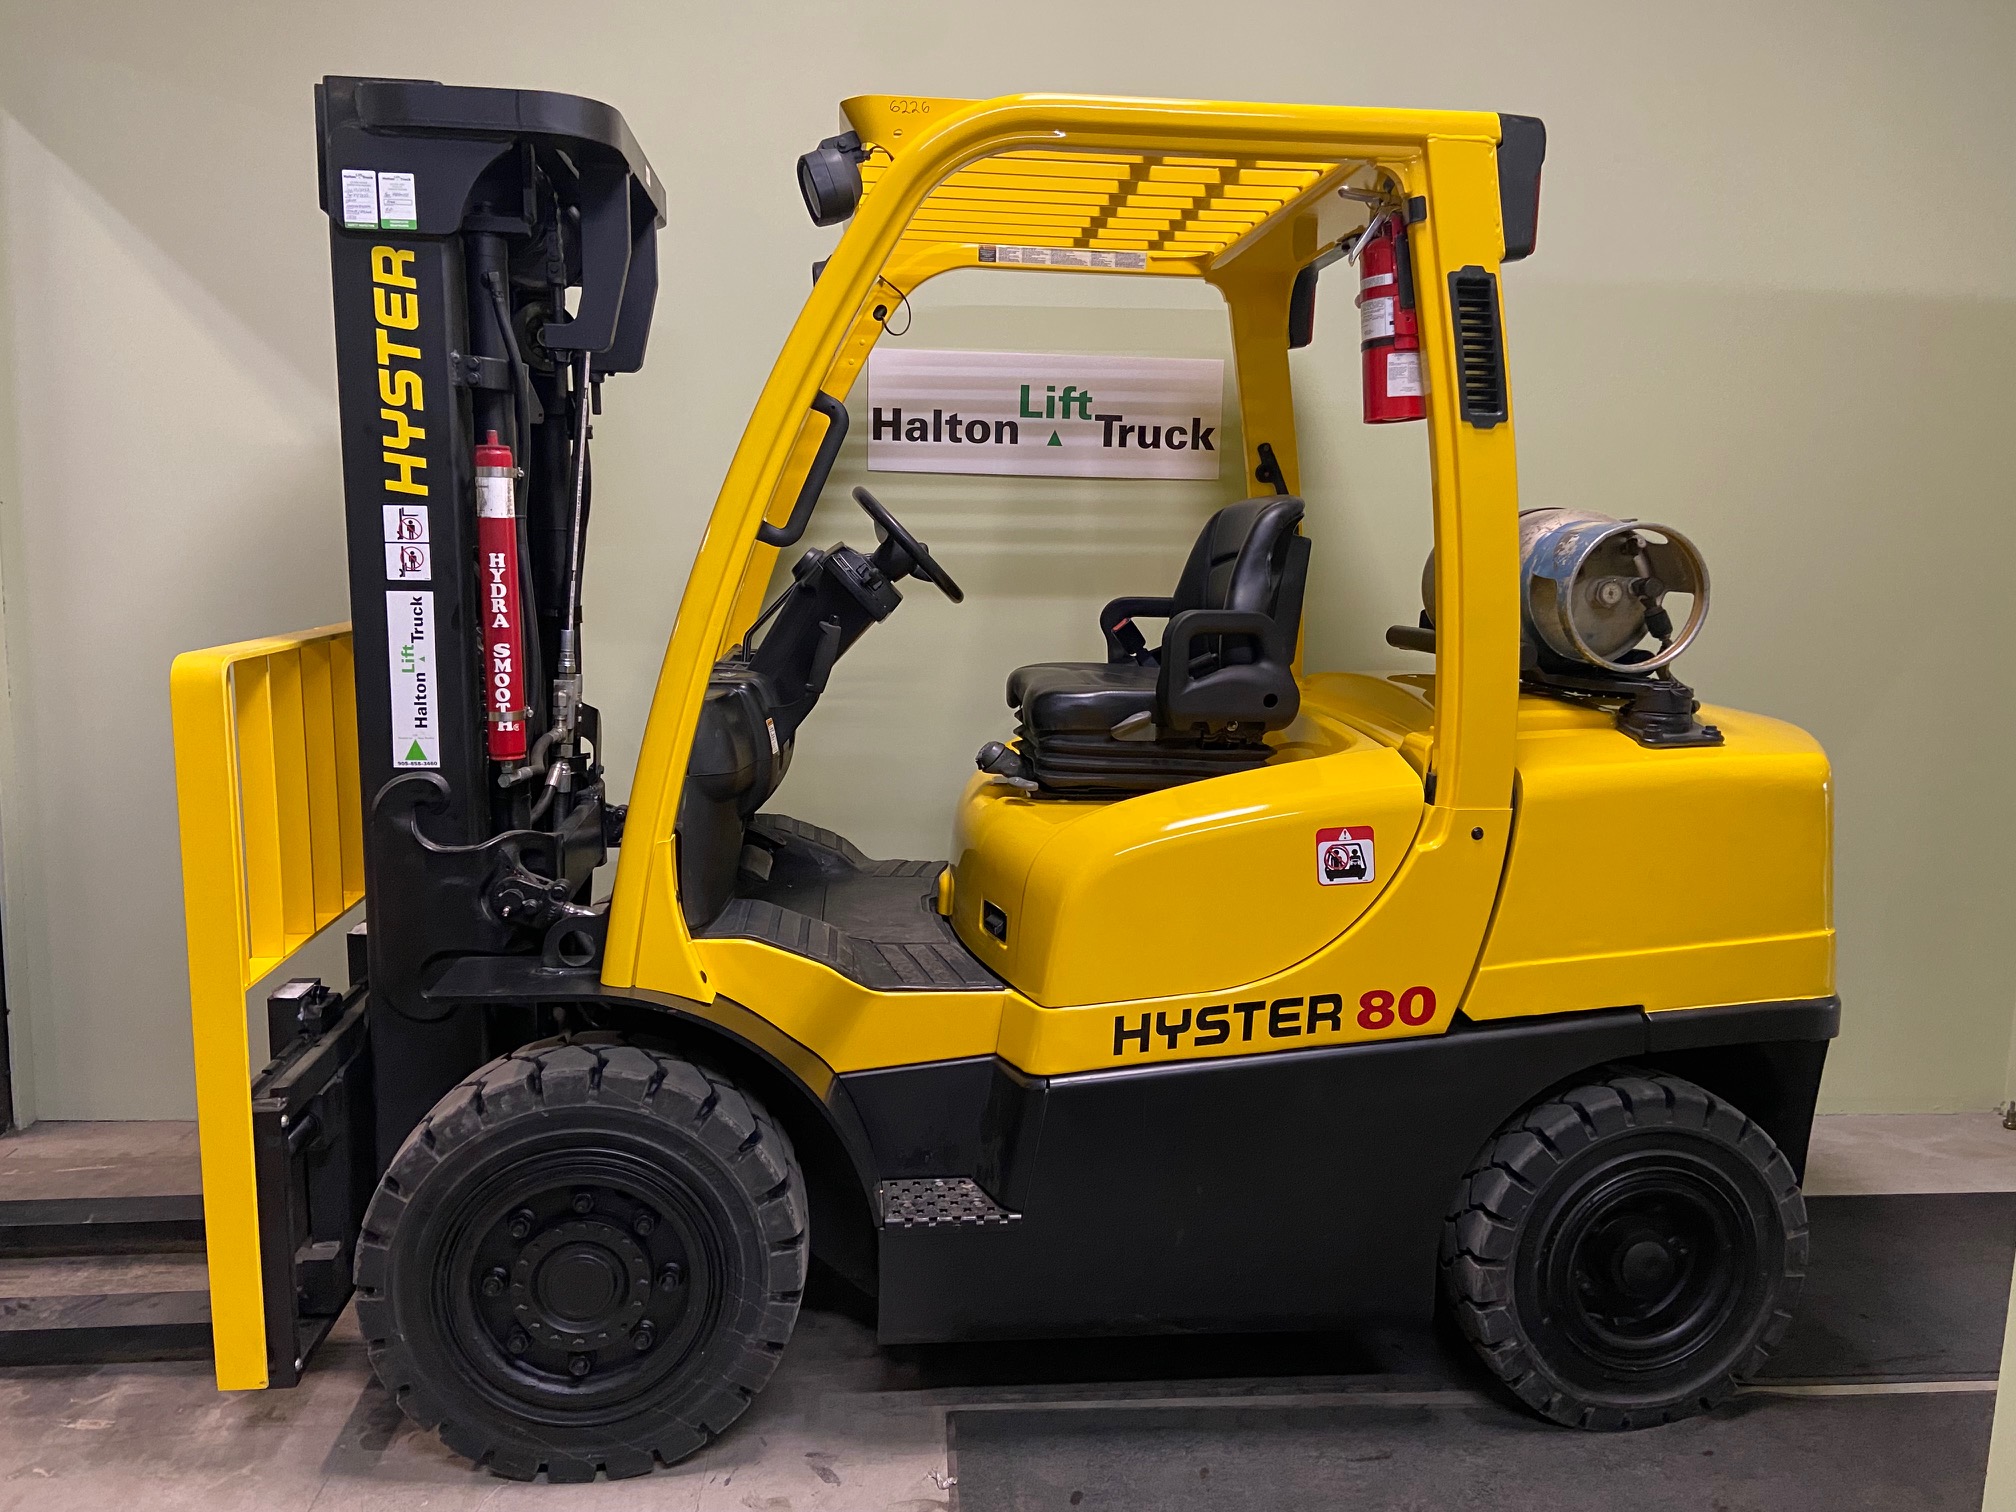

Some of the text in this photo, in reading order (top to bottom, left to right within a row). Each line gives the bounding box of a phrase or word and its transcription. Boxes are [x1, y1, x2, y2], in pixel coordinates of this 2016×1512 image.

[889, 99, 930, 114] 6226
[371, 245, 429, 497] HYSTER
[872, 384, 1216, 451] Halton Lift Truck
[401, 596, 428, 729] Halton Lift Truck
[488, 553, 514, 732] HYDRA SMOOTH
[1113, 986, 1437, 1056] HYSTER 80
